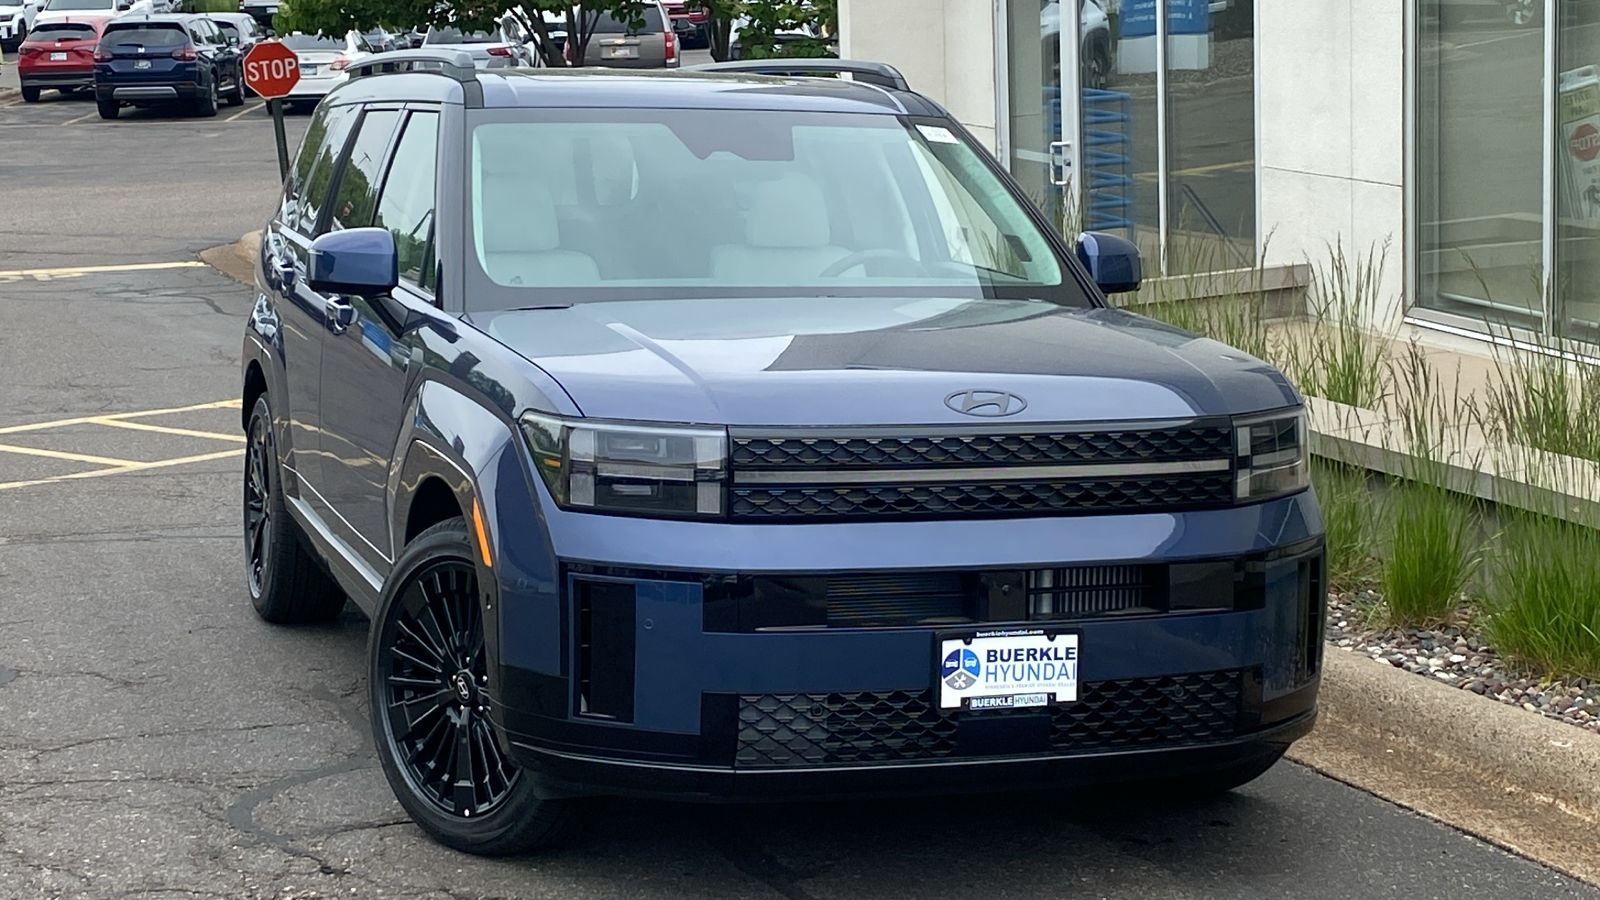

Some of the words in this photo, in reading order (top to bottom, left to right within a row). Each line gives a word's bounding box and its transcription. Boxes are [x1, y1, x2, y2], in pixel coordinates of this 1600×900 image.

[247, 57, 297, 82] STOP
[986, 647, 1076, 663] BUERKLE
[985, 662, 1076, 682] HYUNDAI
[971, 696, 1014, 709] BUERKLE
[1014, 695, 1046, 705] HYUNDAI
